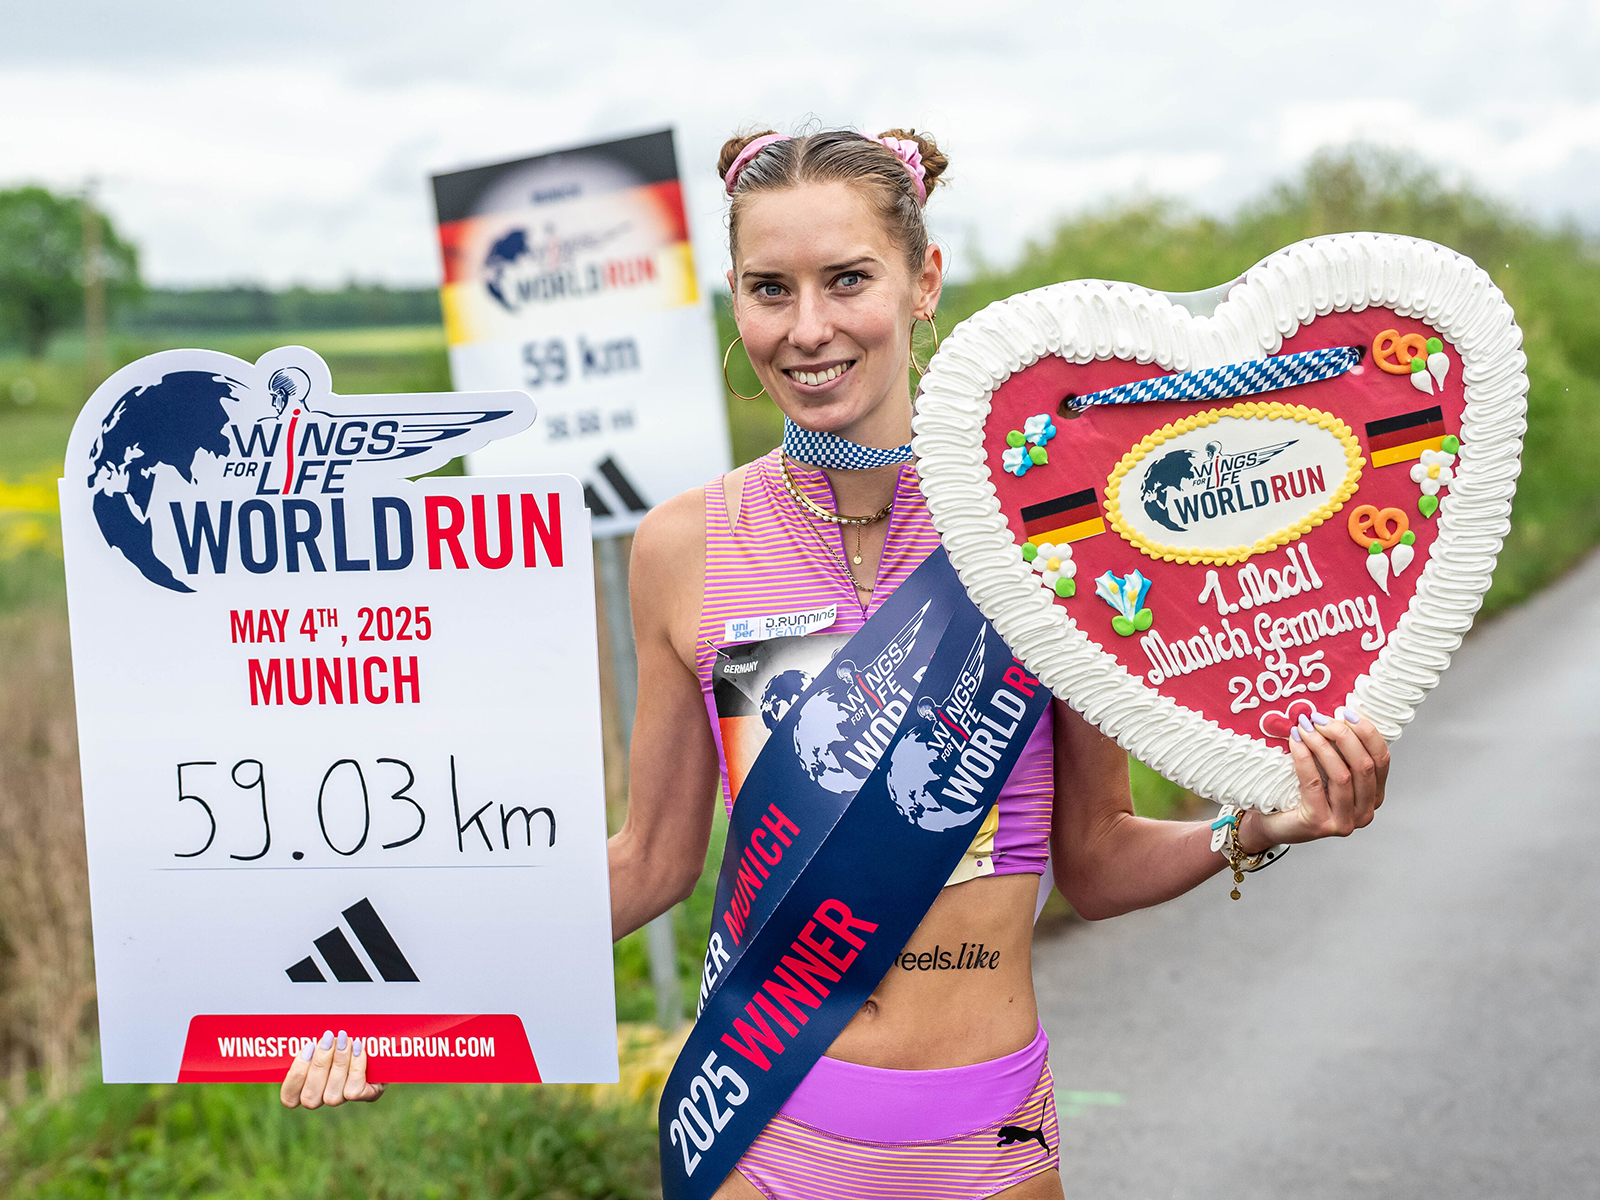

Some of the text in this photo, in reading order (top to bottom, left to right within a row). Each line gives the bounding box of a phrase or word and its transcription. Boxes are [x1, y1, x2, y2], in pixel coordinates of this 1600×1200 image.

[520, 333, 641, 388] 59 km
[223, 459, 353, 495] FOR LIFE
[1192, 469, 1241, 490] FOR LIFE
[230, 609, 290, 643] MAY
[358, 606, 432, 641] 2025
[732, 620, 749, 632] uni
[735, 629, 755, 639] per
[248, 656, 421, 706] MUNICH
[723, 661, 759, 674] GERMANY
[1228, 650, 1331, 714] 2025
[850, 672, 901, 725] FOR LIFE
[941, 701, 982, 762] FOR LIFE
[941, 689, 1026, 805] WORLD
[174, 754, 556, 861] 59.03 km
[723, 803, 801, 946] MUNICH
[669, 899, 879, 1177] 2025 WINNER
